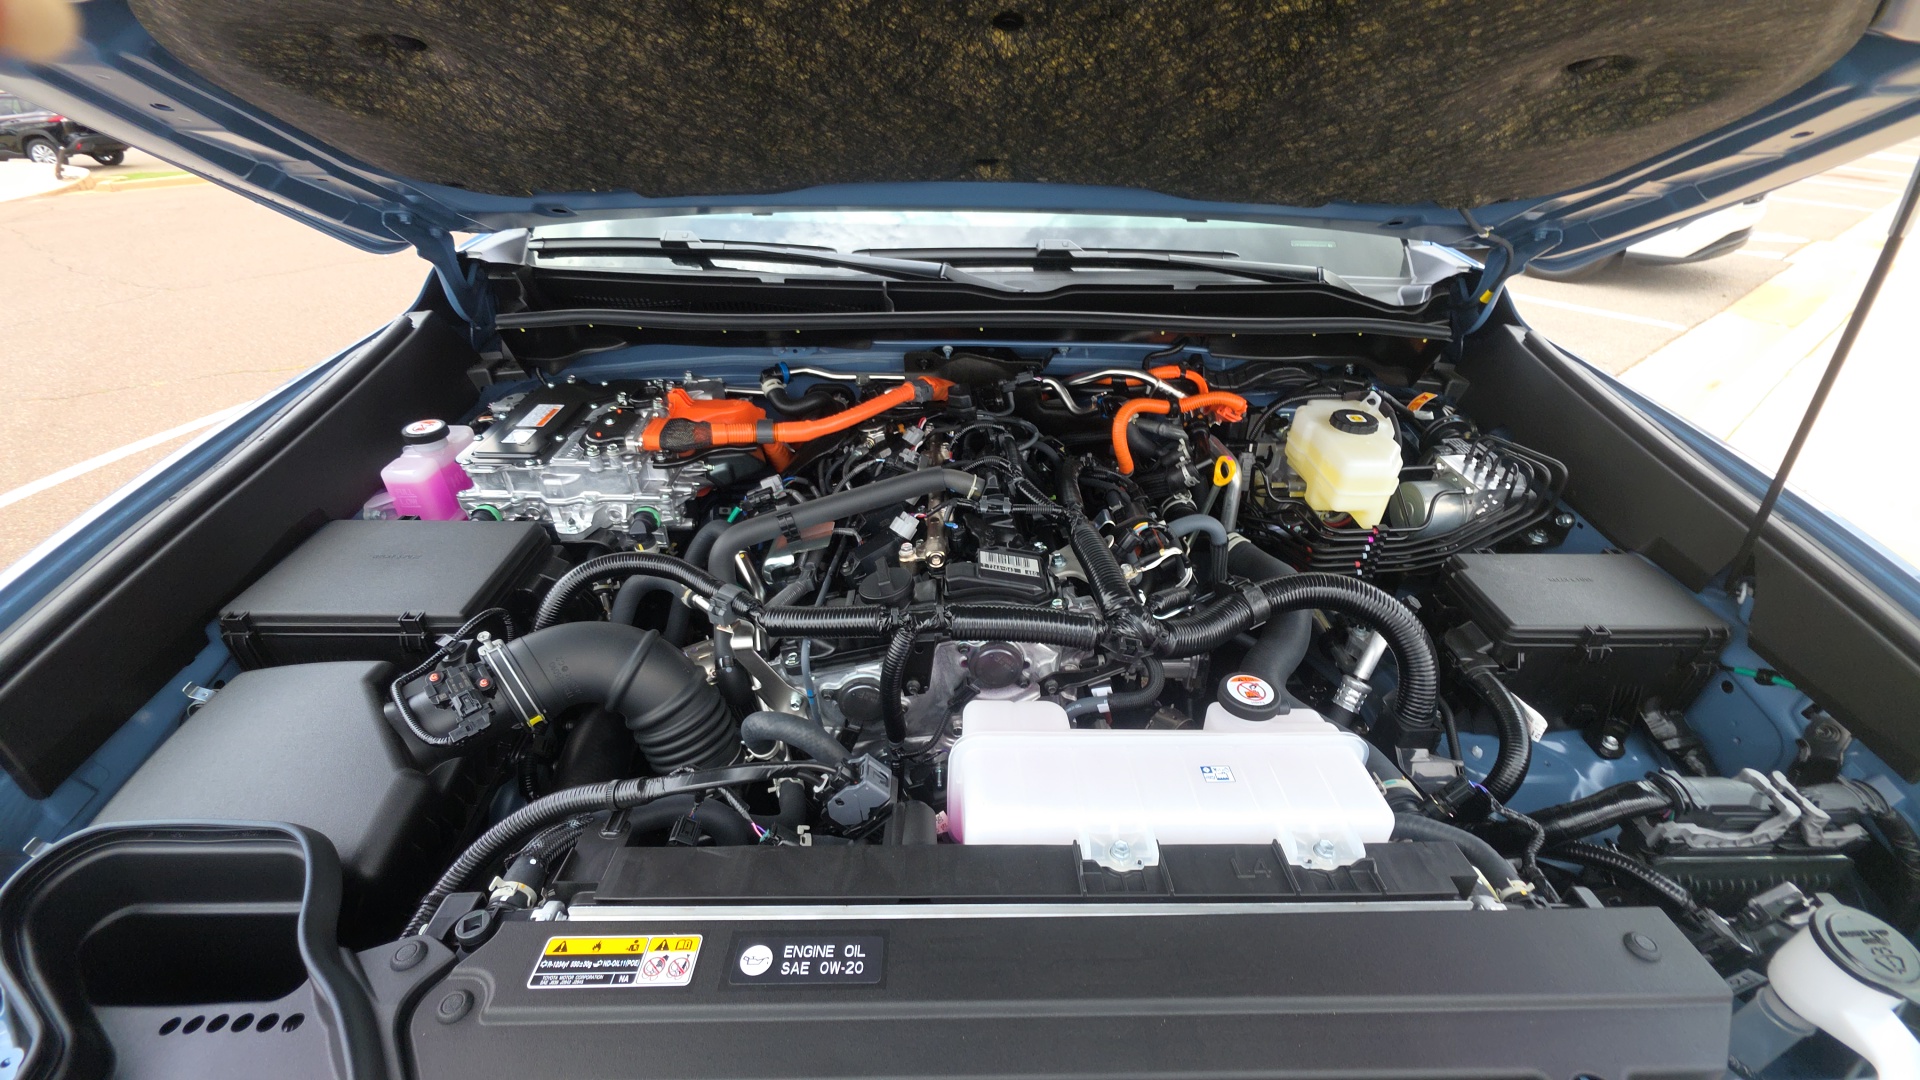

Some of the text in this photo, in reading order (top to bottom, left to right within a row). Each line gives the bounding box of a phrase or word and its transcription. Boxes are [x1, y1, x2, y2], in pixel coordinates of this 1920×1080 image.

[784, 944, 866, 958] ENGINE OIL
[780, 961, 811, 975] SAE
[618, 975, 630, 983] NA
